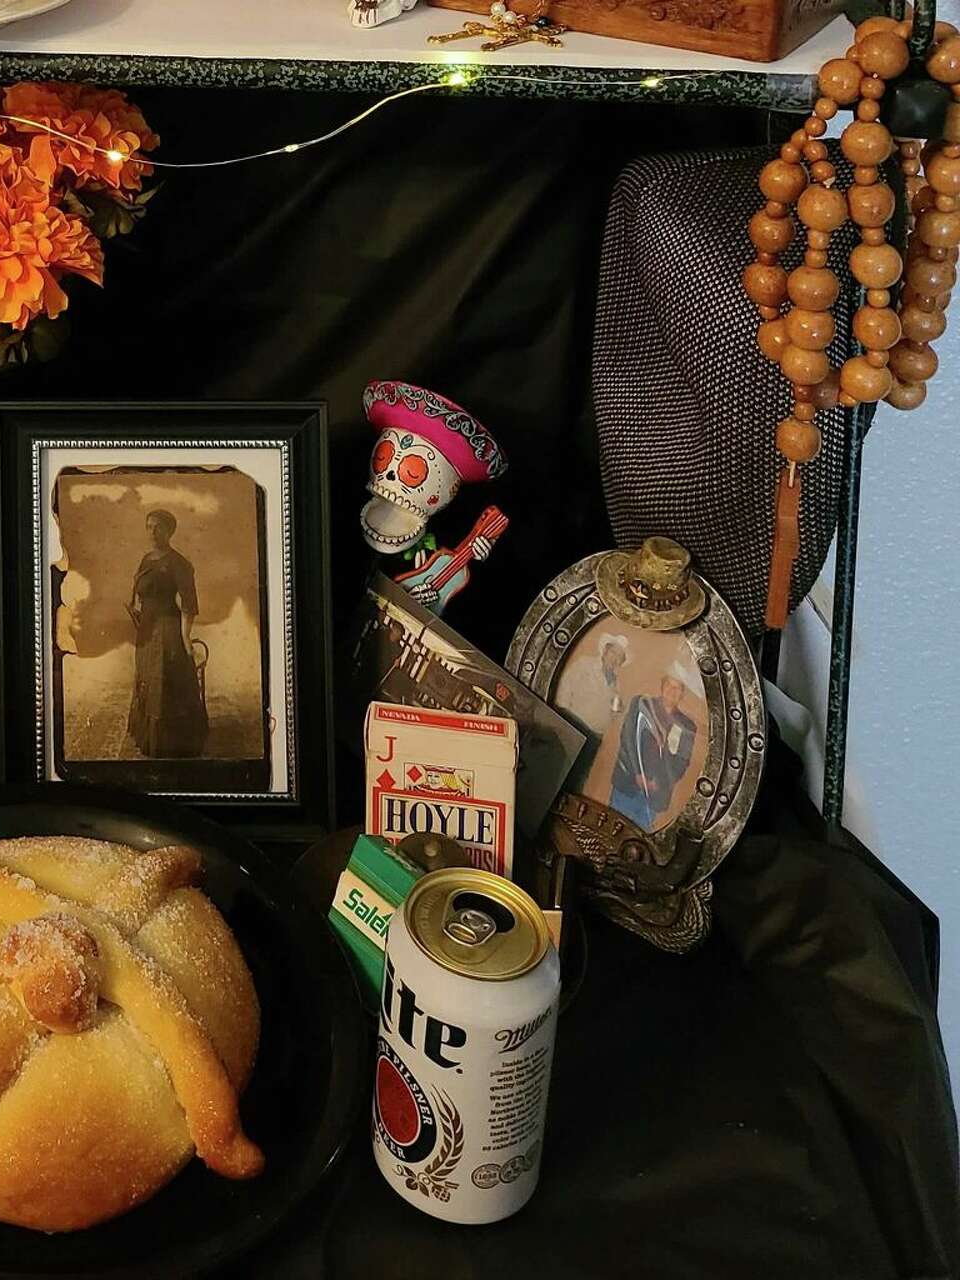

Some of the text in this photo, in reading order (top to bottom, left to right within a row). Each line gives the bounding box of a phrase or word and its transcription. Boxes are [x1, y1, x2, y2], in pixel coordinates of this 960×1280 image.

[381, 709, 499, 732] NEVADA FINISH
[376, 735, 397, 762] J
[384, 798, 494, 845] HOYLE
[381, 951, 467, 1069] ite
[393, 1055, 433, 1126] PILSNER
